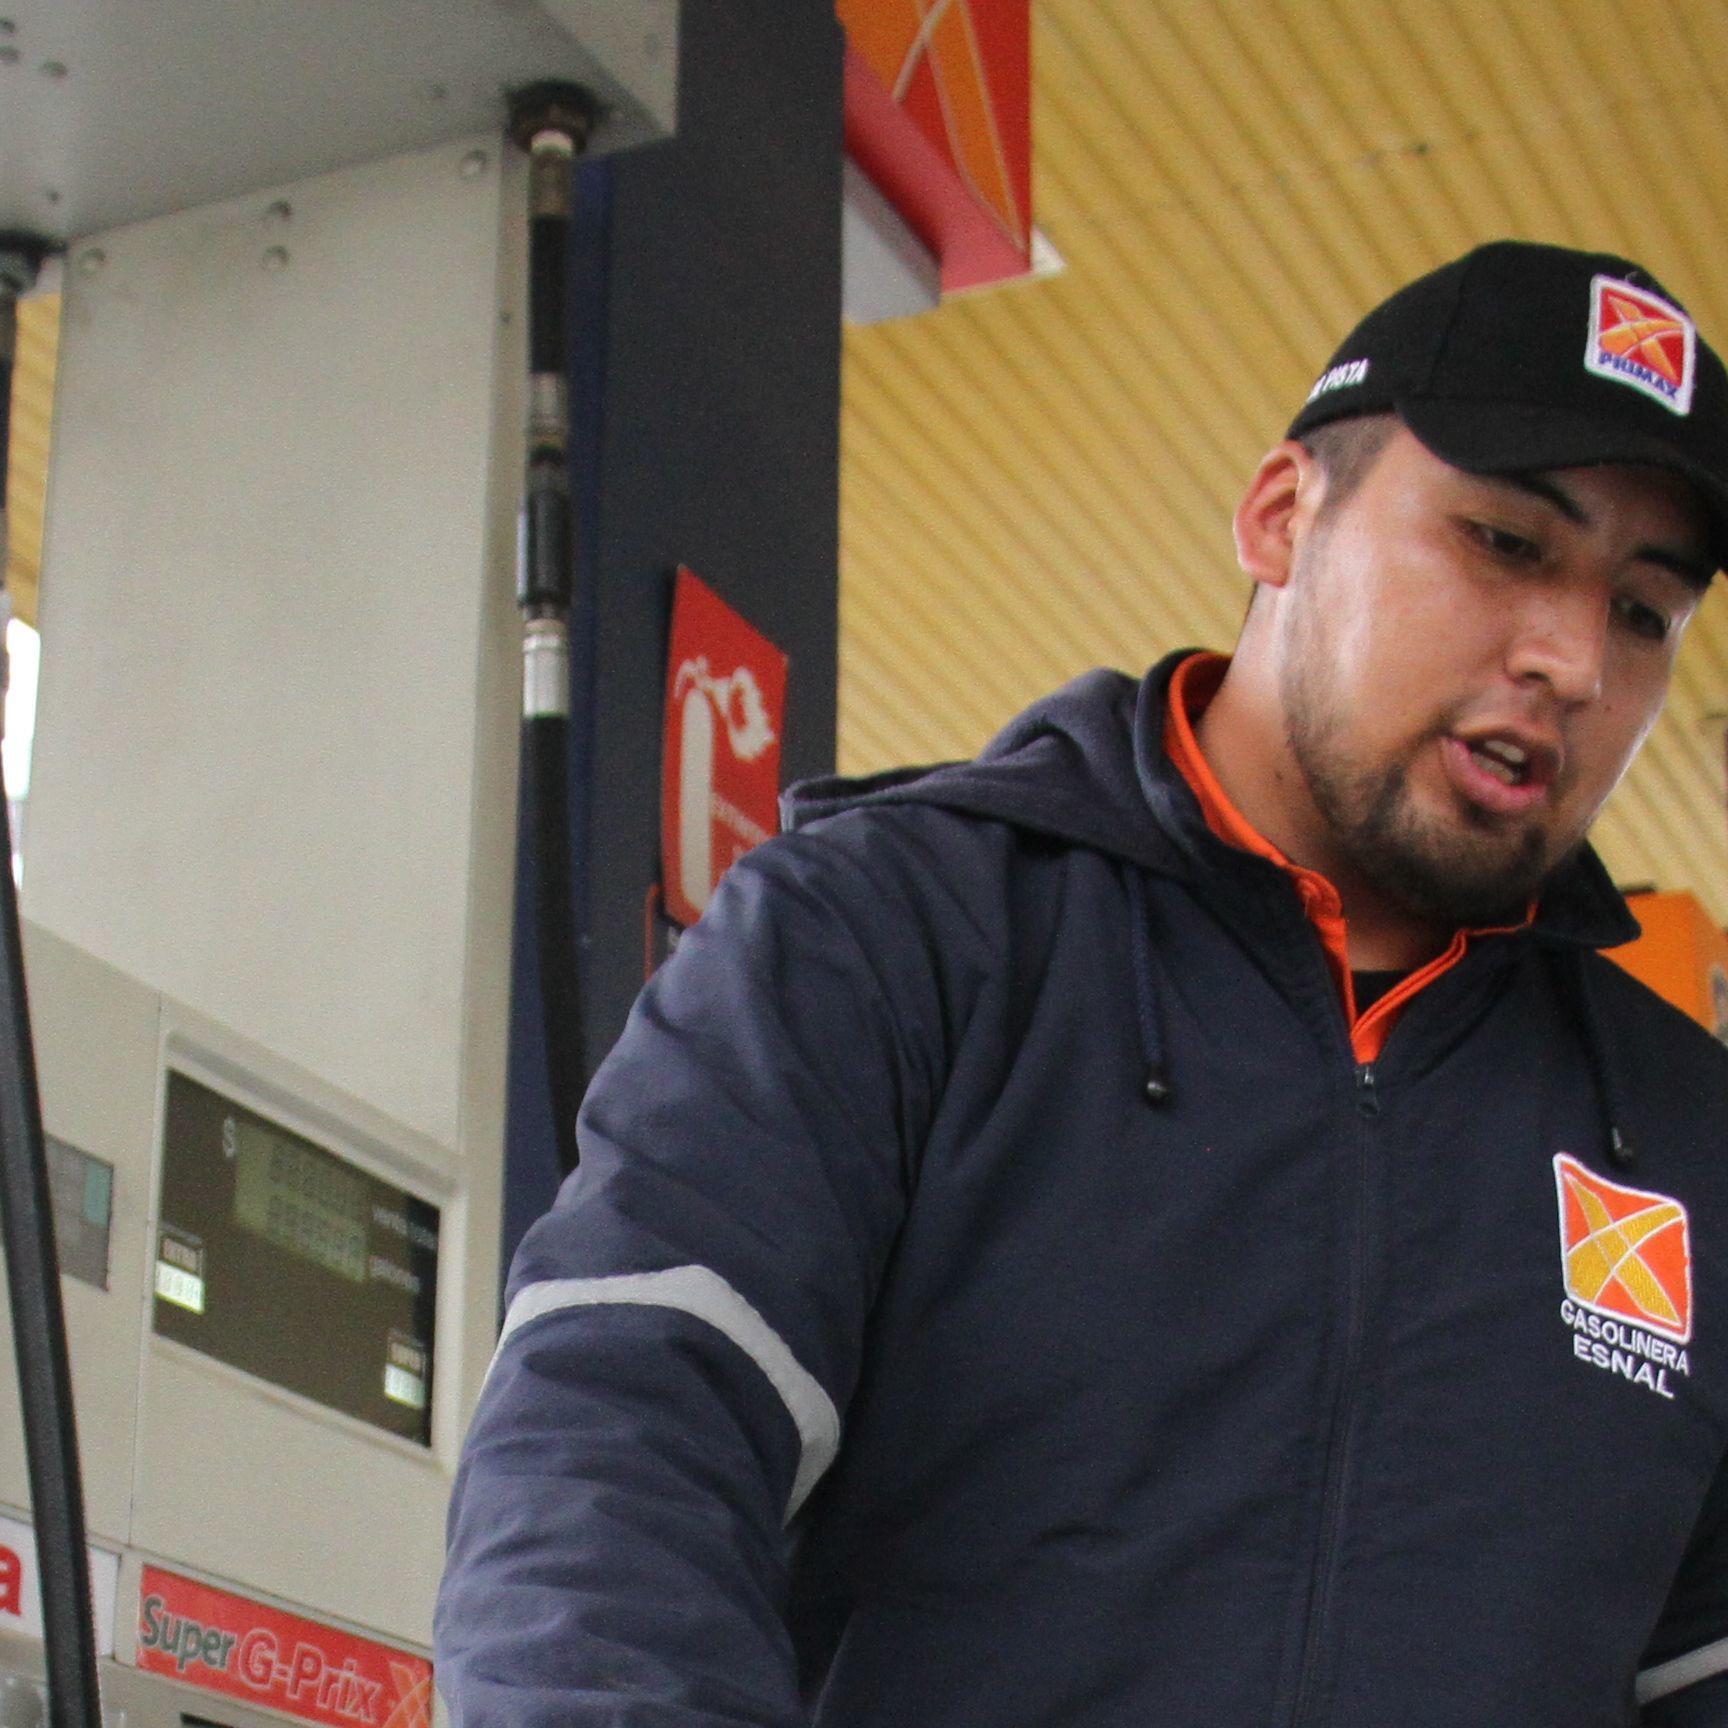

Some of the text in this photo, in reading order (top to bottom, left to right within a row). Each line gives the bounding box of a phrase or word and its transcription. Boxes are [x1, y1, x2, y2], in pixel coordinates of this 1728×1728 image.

[1560, 1300, 1690, 1376] GASOLINERA
[1573, 1334, 1674, 1399] ESNAL
[139, 1594, 383, 1723] Super G-Prix
